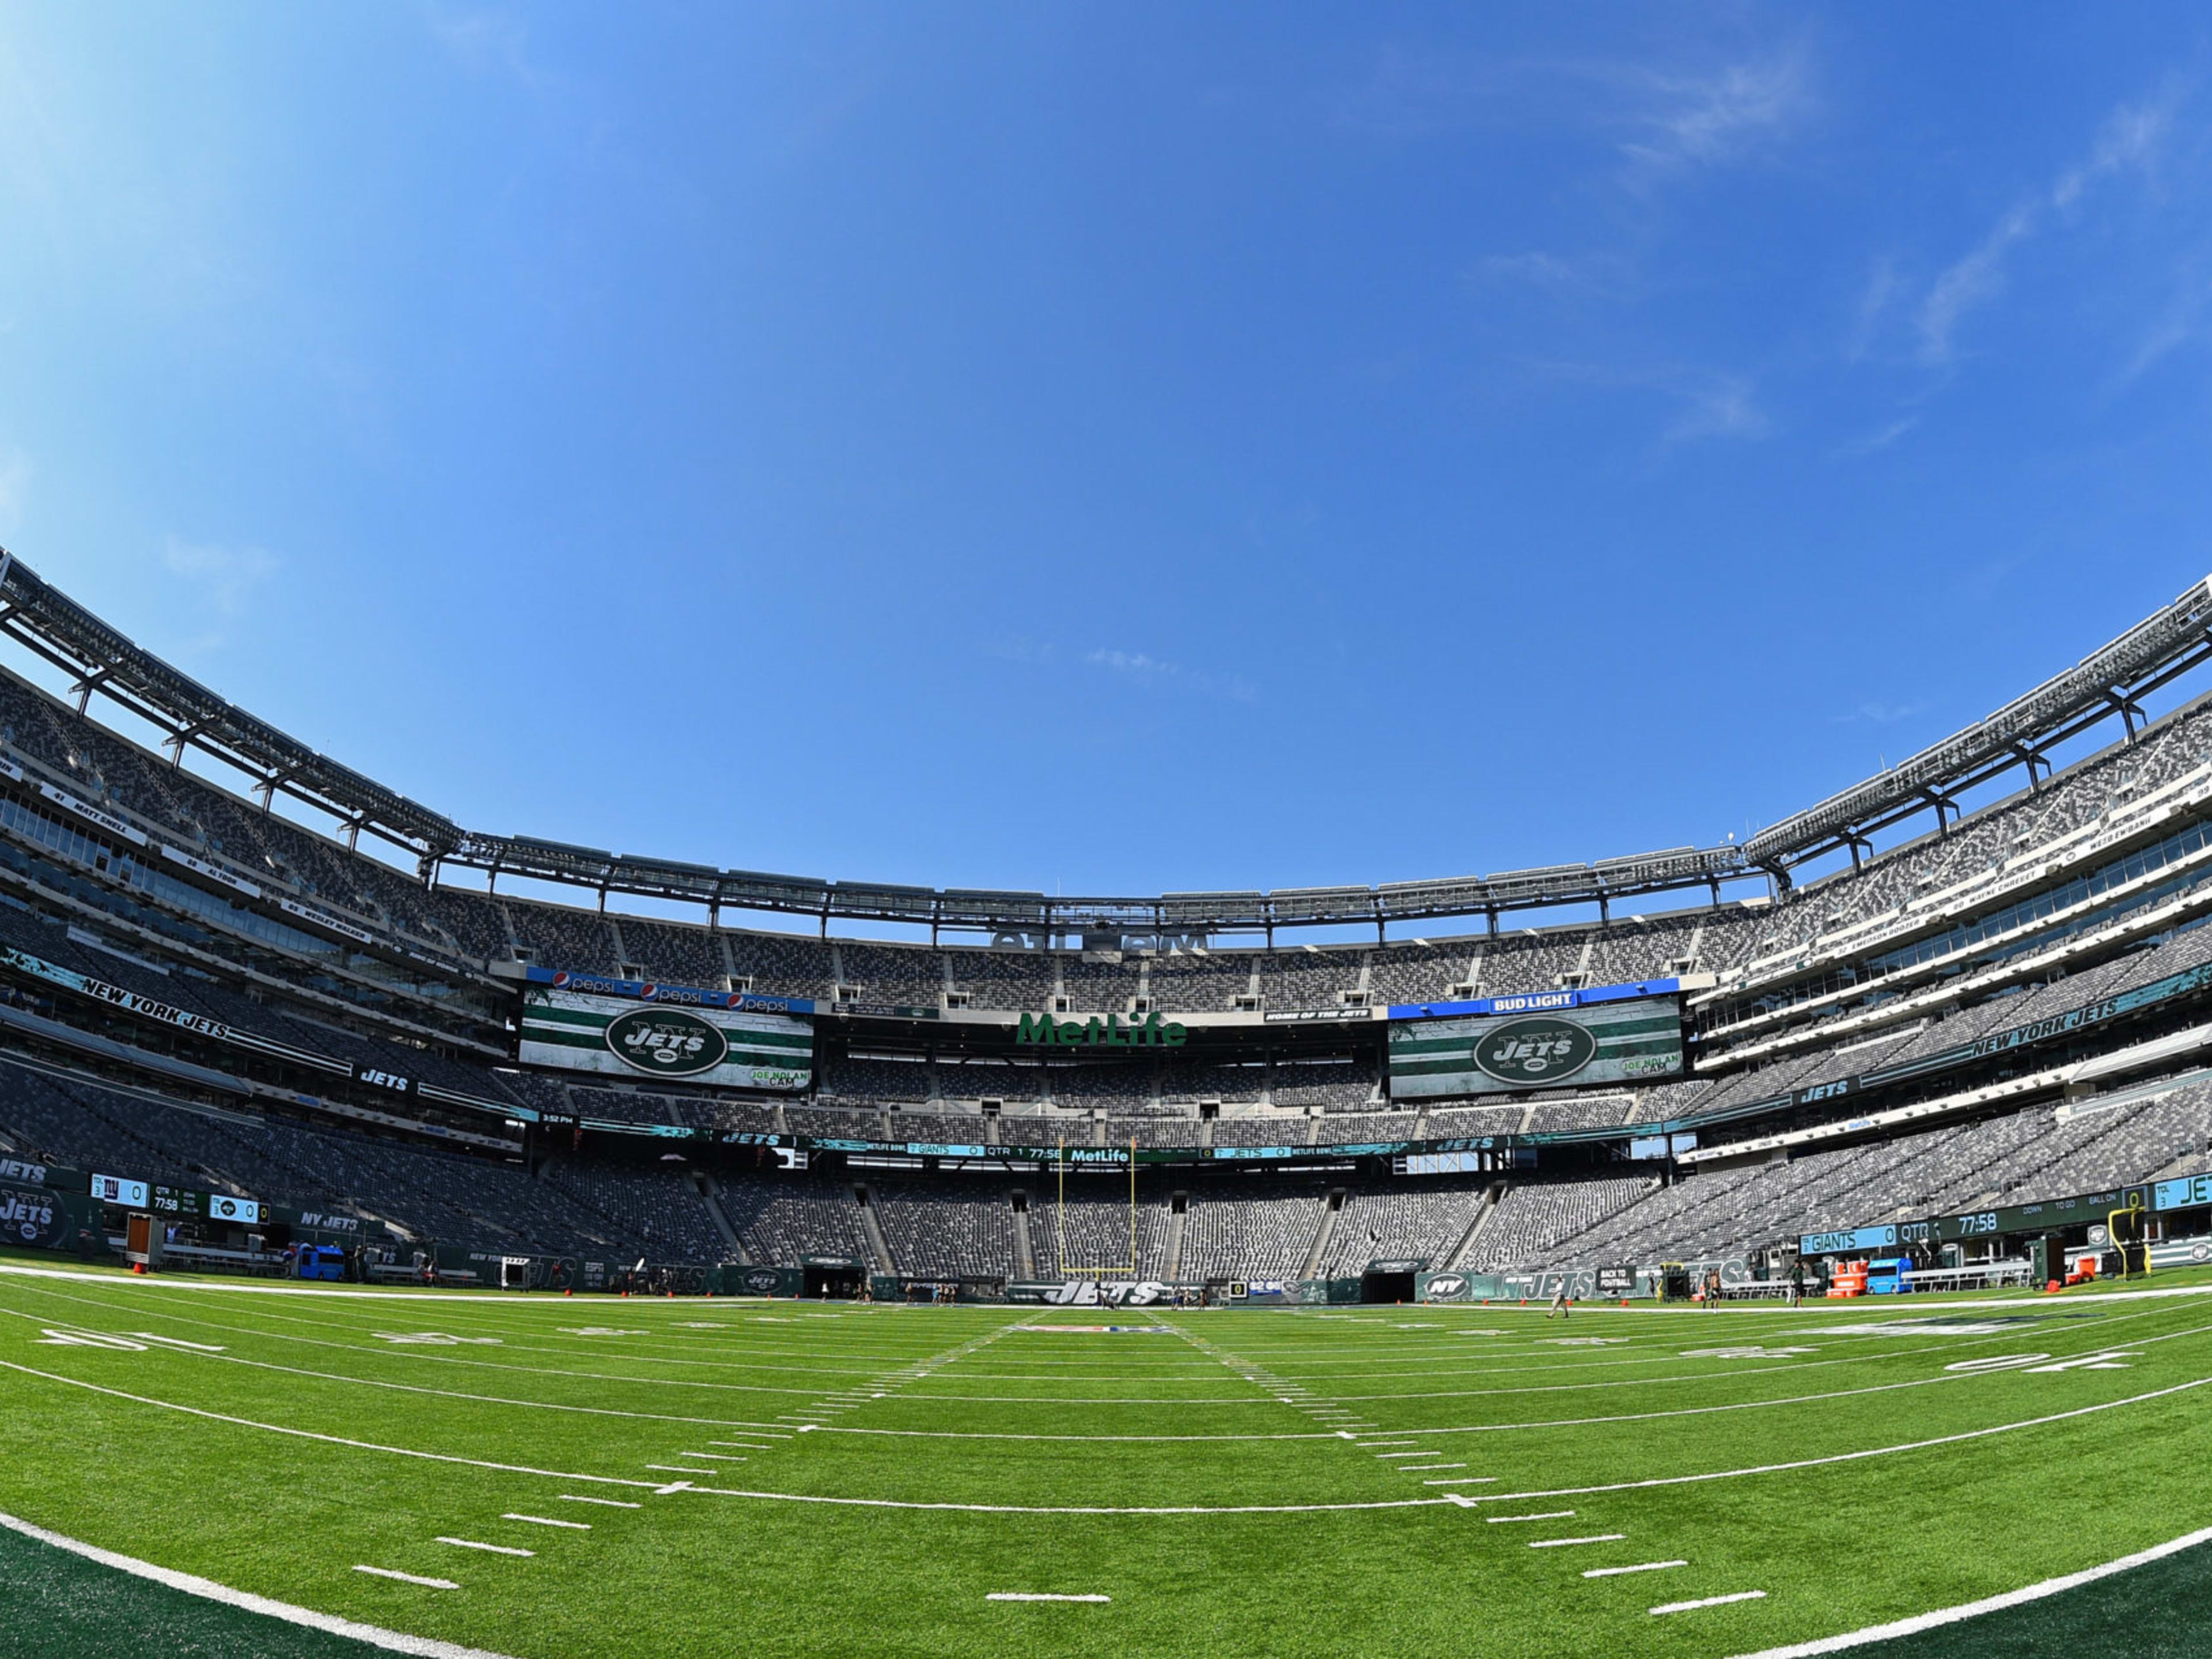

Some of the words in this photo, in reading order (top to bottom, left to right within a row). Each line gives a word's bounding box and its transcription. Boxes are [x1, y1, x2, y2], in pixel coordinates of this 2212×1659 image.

[74, 802, 100, 819] MATT
[100, 816, 127, 834] SNELL
[572, 978, 615, 994] pepsi
[658, 988, 702, 1004] pepsi
[1494, 998, 1528, 1011] BUD
[1528, 993, 1573, 1008] LIGHT
[83, 978, 128, 1003] NEW
[128, 995, 180, 1024] YORK
[183, 1015, 228, 1037] JETS
[745, 998, 789, 1013] pepsi
[1266, 1012, 1298, 1020] HOME
[1340, 1009, 1368, 1017] JETS
[1016, 1010, 1187, 1046] MetLife
[1972, 1032, 2013, 1056] NEW
[2017, 1017, 2067, 1040] YORK
[2071, 999, 2119, 1027] JETS
[624, 1028, 705, 1052] JETS
[1493, 1039, 1573, 1061] JETS
[361, 1069, 408, 1090] JETS
[1800, 1080, 1849, 1103] JETS
[722, 1132, 780, 1145] JETS
[1437, 1137, 1494, 1151] JETS
[918, 1145, 950, 1154] GIANTS
[987, 1147, 1010, 1157] QTR
[1070, 1149, 1129, 1162] MetLife
[1230, 1148, 1263, 1157] JETS
[0, 1198, 53, 1225] JETS
[301, 1212, 323, 1225] NY
[323, 1217, 358, 1231] JETS
[1902, 1222, 1929, 1241] QTR
[1959, 1212, 1997, 1234] 77:58
[1812, 1232, 1856, 1252] GIANTS
[1618, 1270, 1626, 1278] TO
[1044, 1281, 1165, 1305] JETS
[1234, 1285, 1242, 1295] 0
[1430, 1279, 1464, 1293] NY
